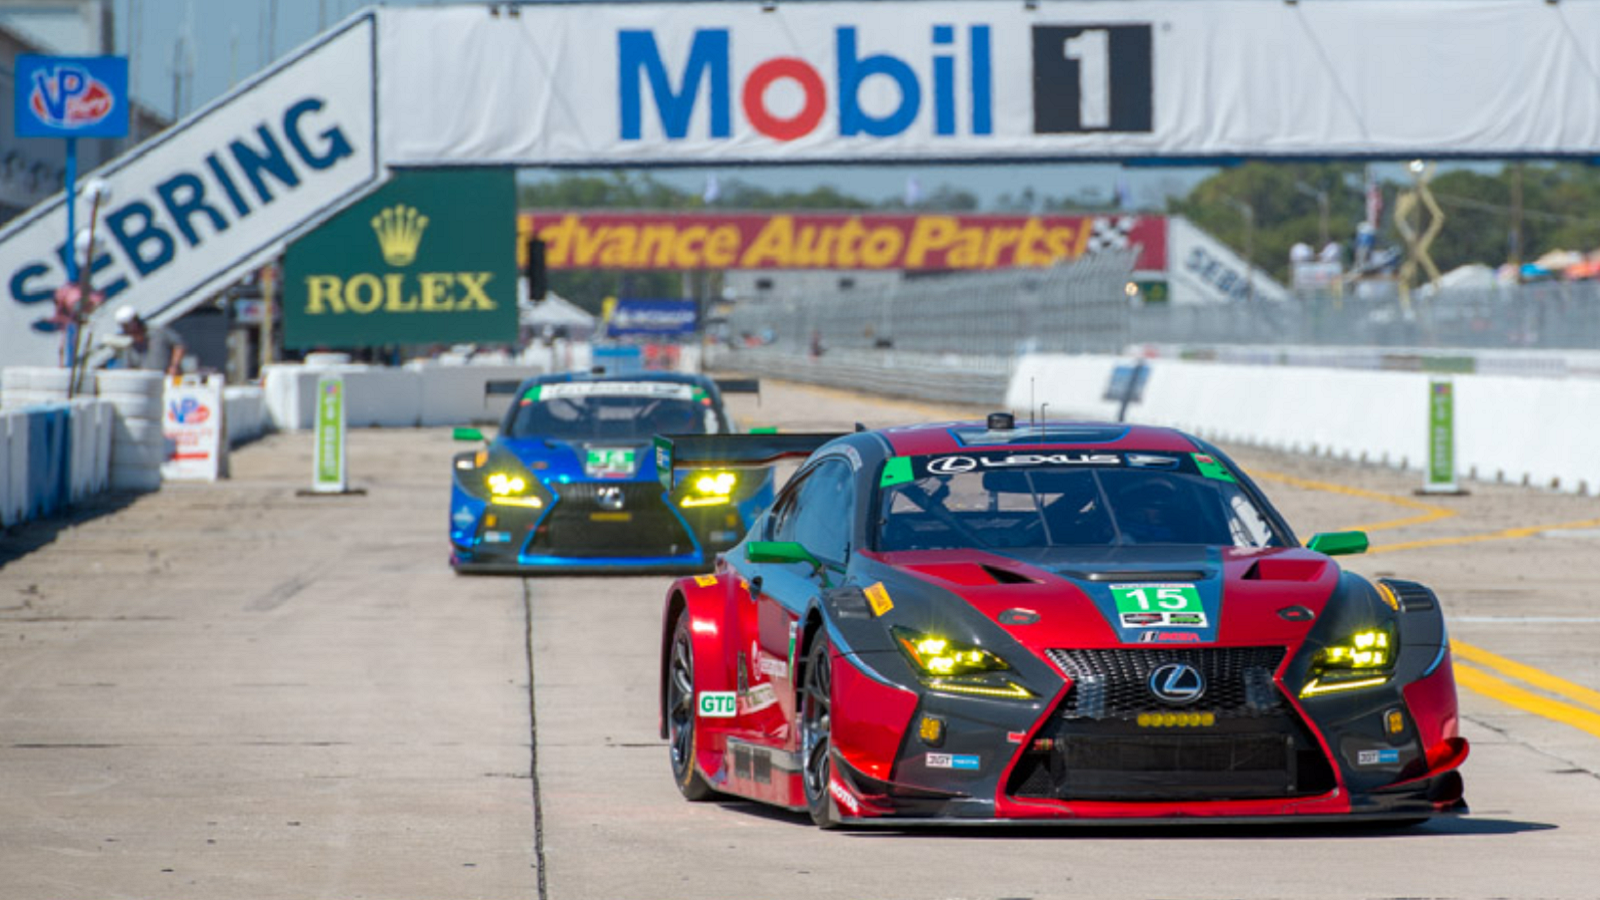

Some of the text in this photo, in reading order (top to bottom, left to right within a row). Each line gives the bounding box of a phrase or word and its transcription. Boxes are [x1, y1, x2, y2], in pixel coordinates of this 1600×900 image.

[38, 69, 84, 120] VP
[617, 24, 1110, 142] Mobil 1
[9, 98, 354, 333] SEBRING
[741, 214, 904, 268] Auto
[305, 273, 497, 314] ROLEX
[980, 454, 1121, 467] LEXUS
[1126, 588, 1188, 610] 15
[701, 695, 735, 713] GTD
